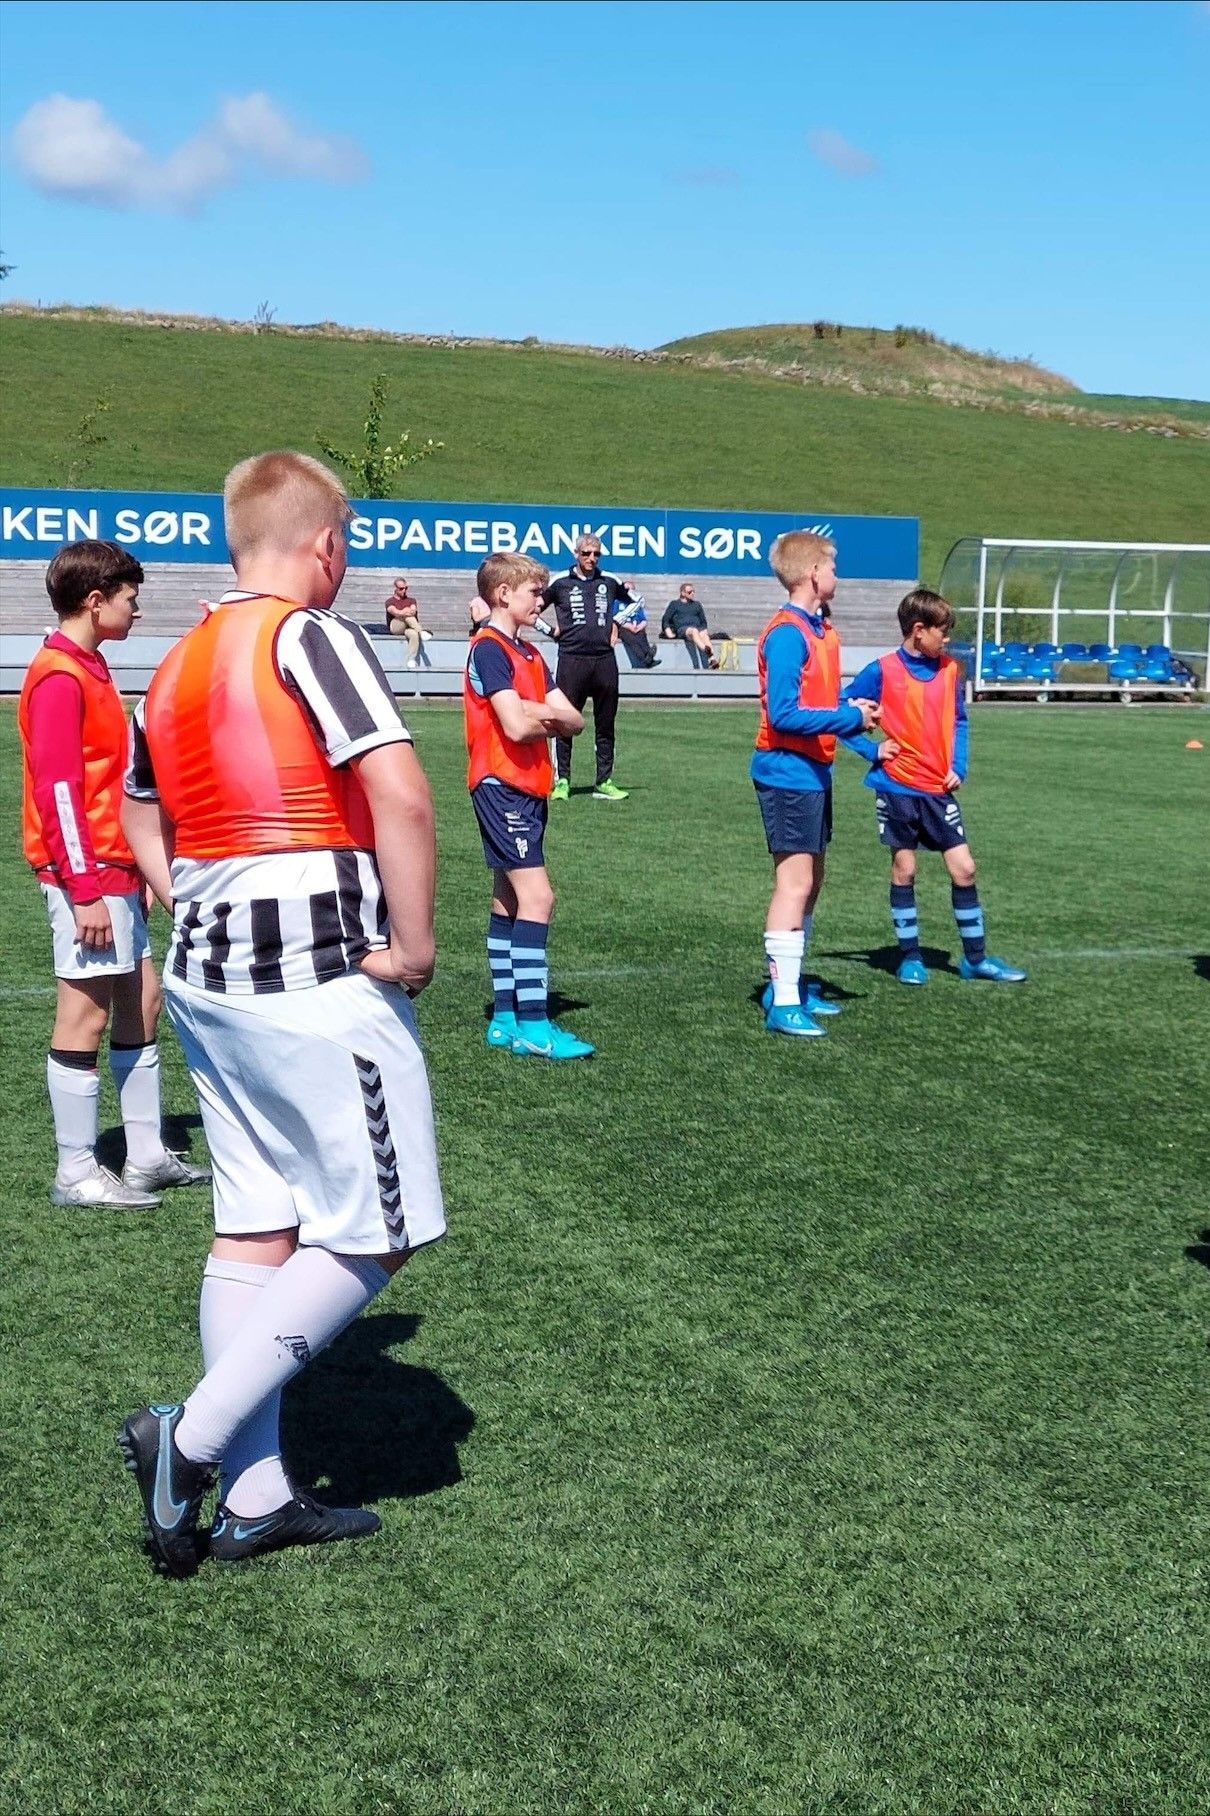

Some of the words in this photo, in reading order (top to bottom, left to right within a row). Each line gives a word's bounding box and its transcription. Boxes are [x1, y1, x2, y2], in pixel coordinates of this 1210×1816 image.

[3, 506, 98, 541] KEN
[114, 509, 211, 545] SØR
[679, 526, 762, 560] SØR
